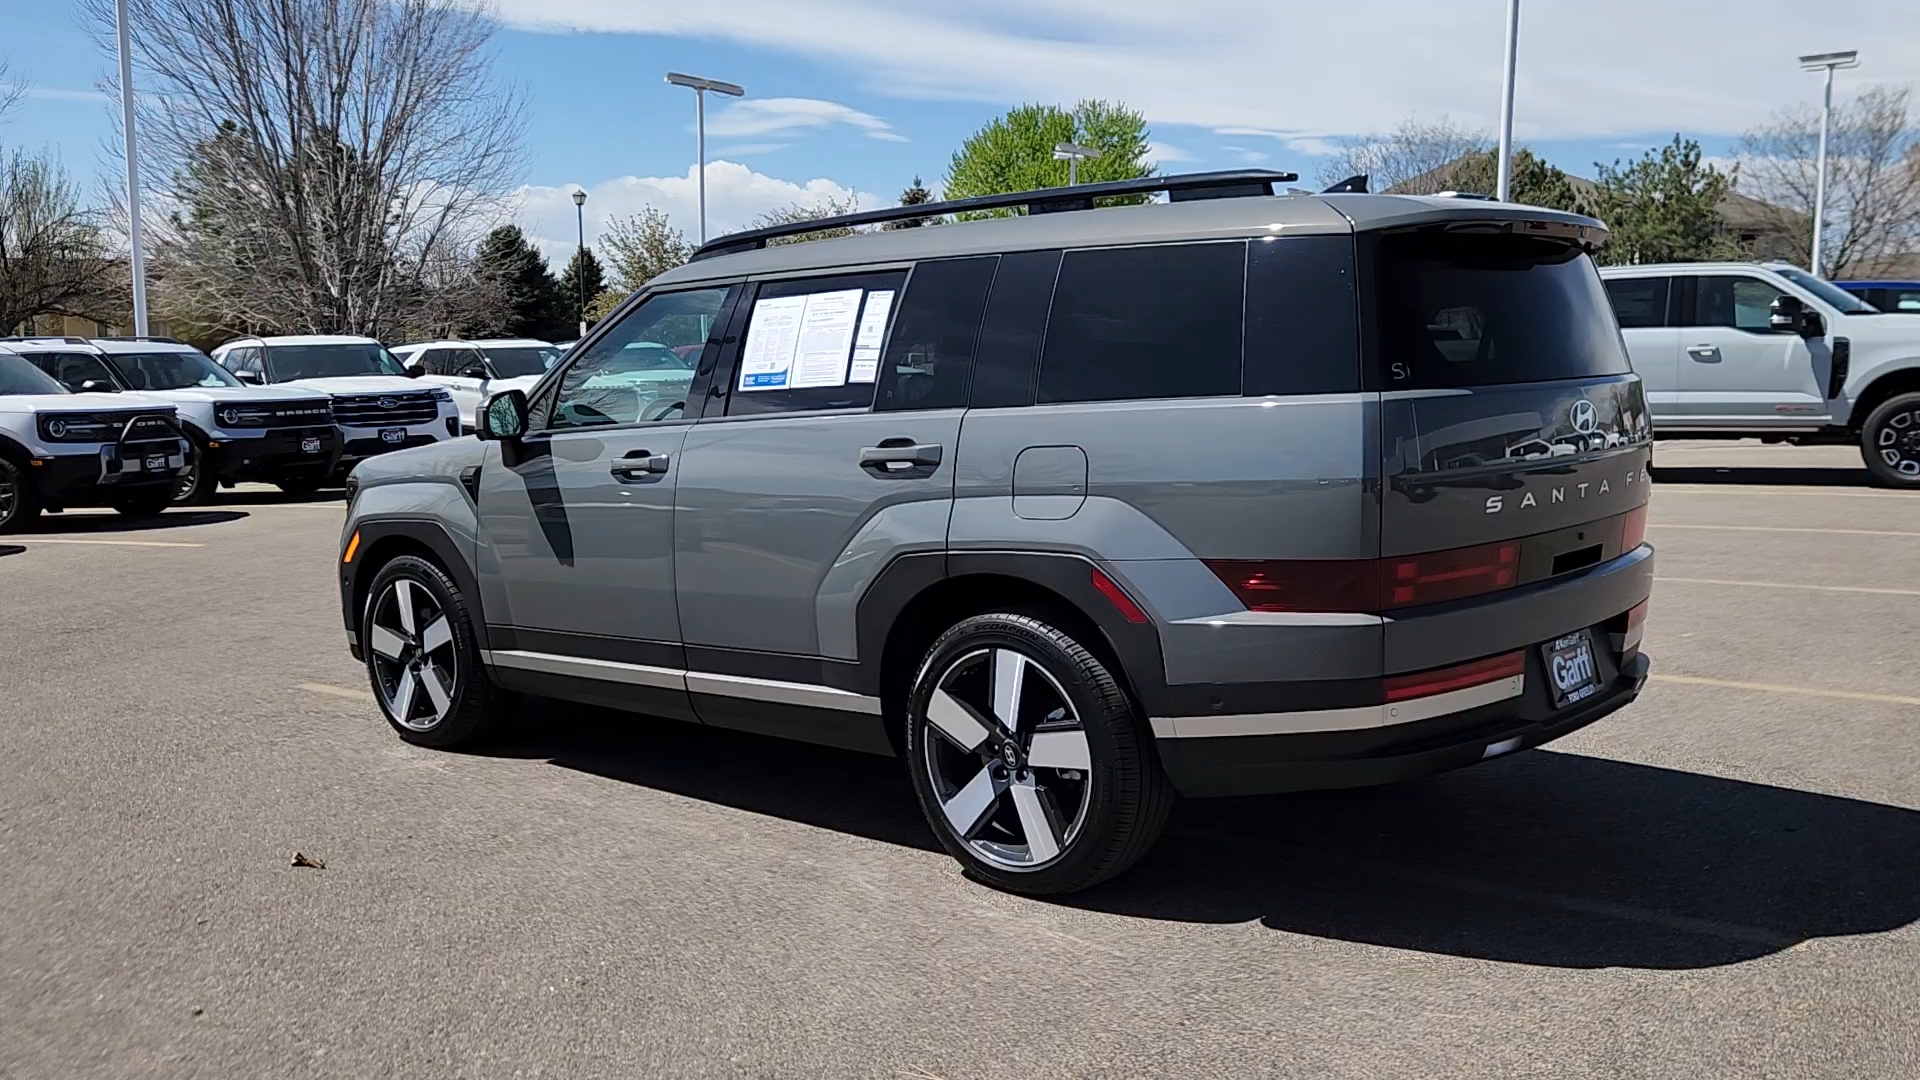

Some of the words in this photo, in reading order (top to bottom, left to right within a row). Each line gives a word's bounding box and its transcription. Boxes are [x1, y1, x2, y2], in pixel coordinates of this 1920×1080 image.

[381, 430, 405, 441] Garff
[301, 440, 320, 451] Garff
[1485, 478, 1610, 514] SANTA
[973, 622, 1040, 640] SCORPION
[1552, 645, 1592, 690] Garff
